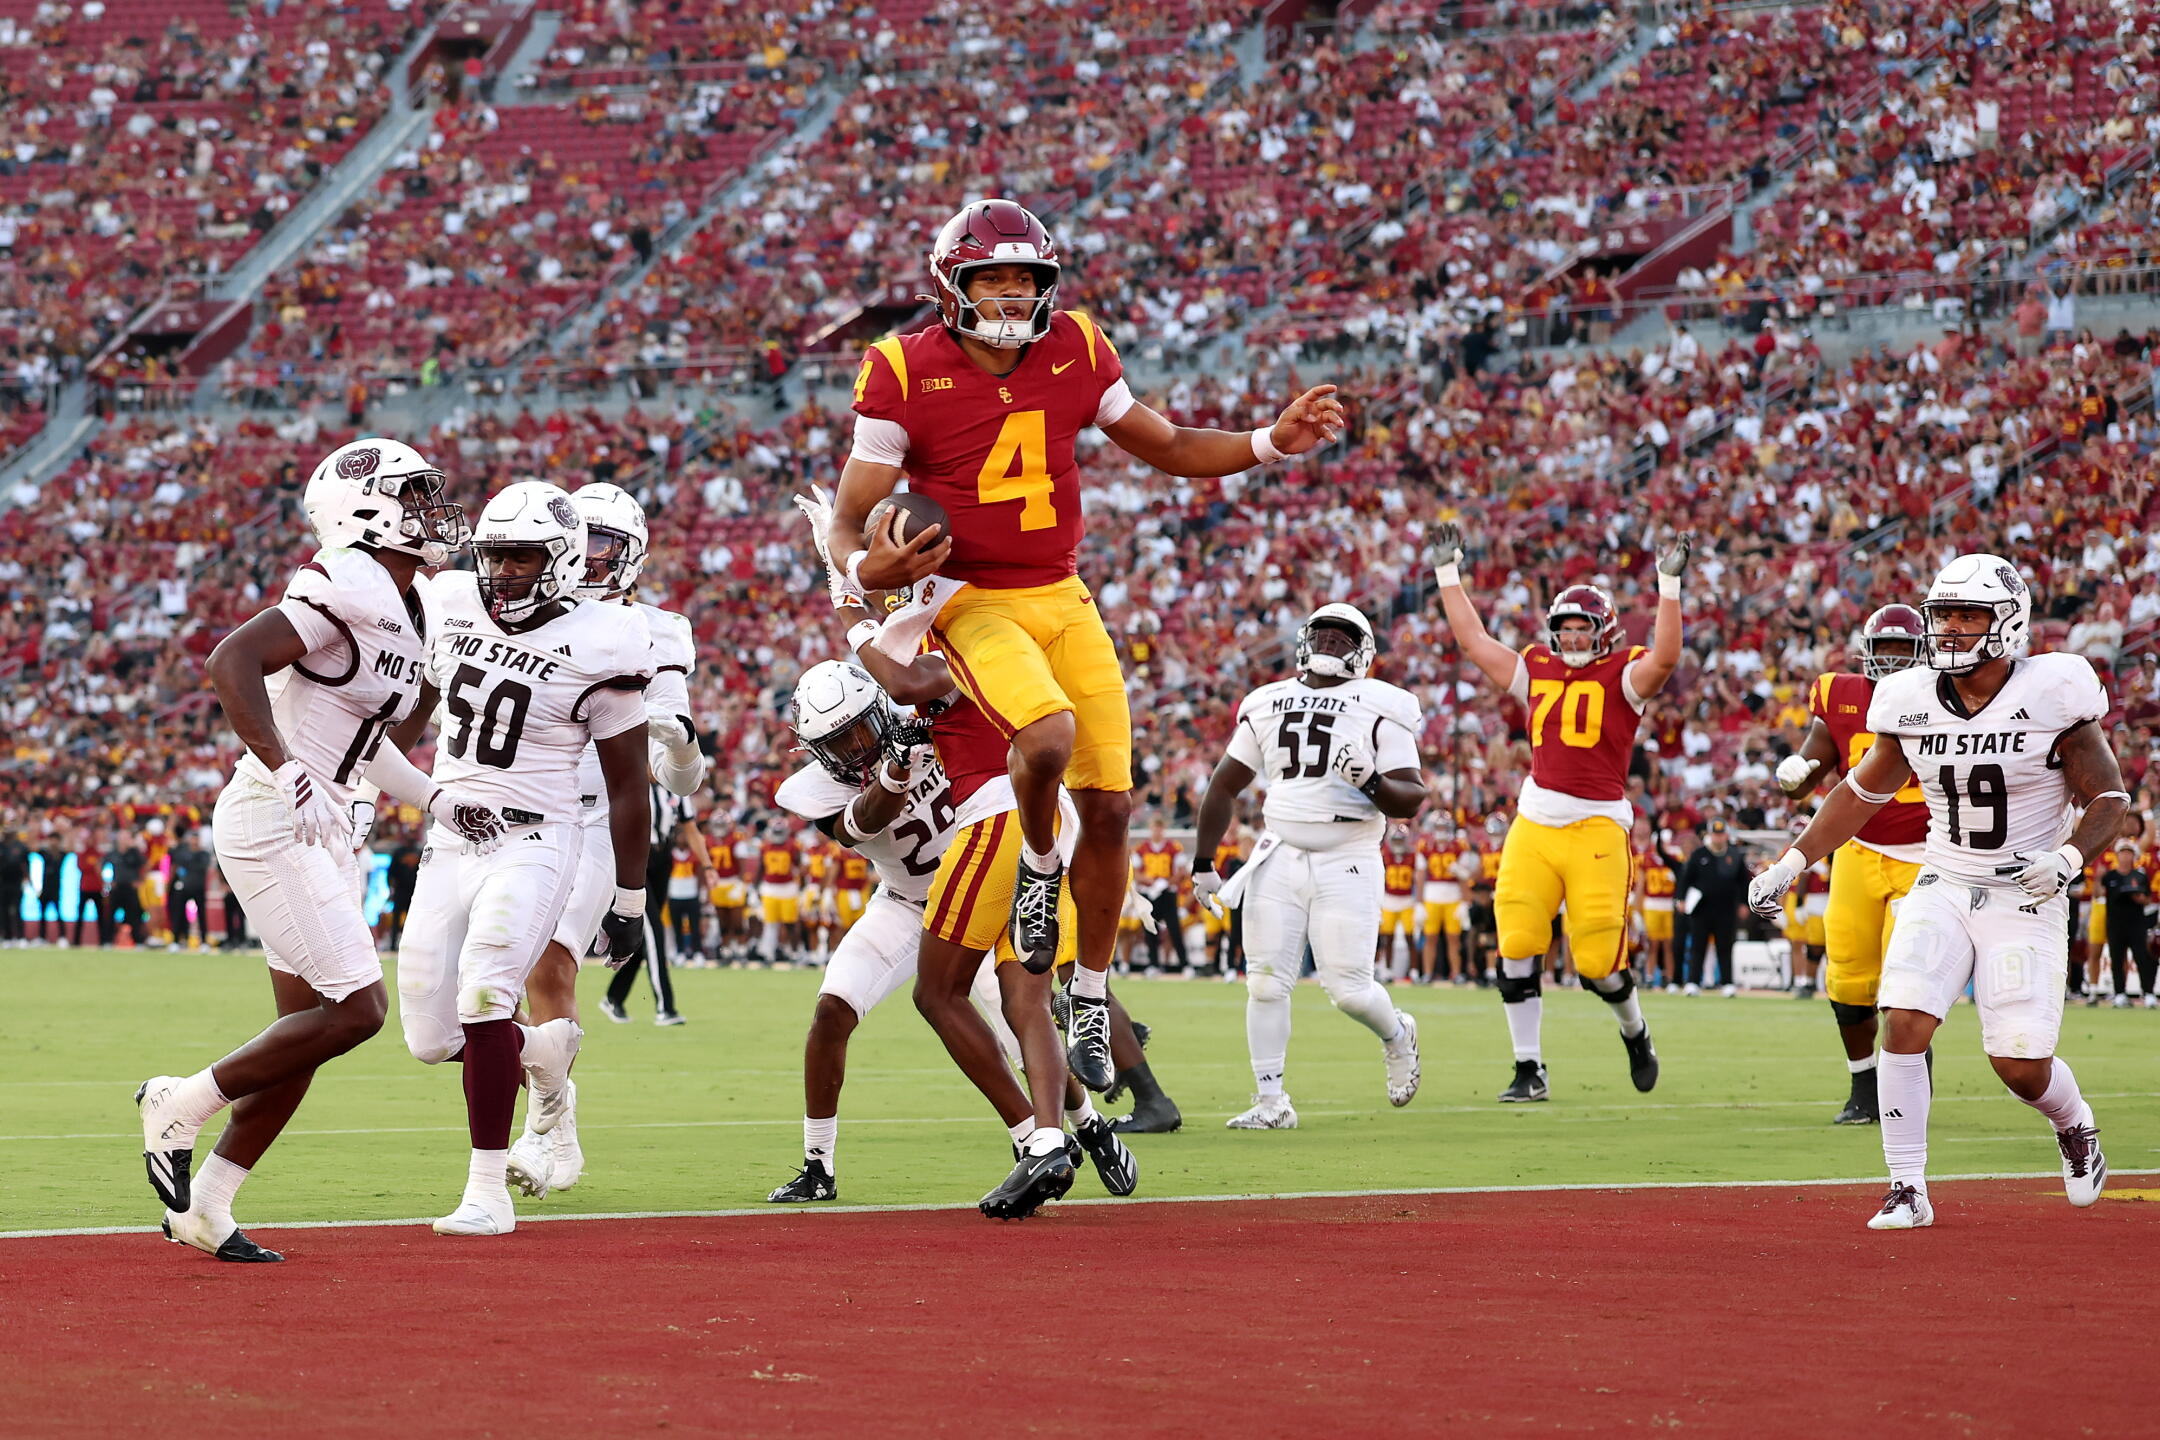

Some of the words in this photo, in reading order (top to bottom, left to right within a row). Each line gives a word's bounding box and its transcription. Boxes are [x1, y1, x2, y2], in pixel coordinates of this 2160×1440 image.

[853, 360, 874, 403] 4
[977, 409, 1058, 532] 4
[374, 649, 405, 680] MO
[450, 635, 483, 657] MO
[484, 642, 560, 682] STATE
[447, 662, 532, 770] 50
[1272, 697, 1294, 713] MO
[1298, 696, 1348, 713] STATE
[1529, 679, 1605, 749] 70
[1278, 712, 1336, 780] 55
[1919, 733, 1948, 756] MO
[1955, 731, 2027, 755] STATE
[1938, 763, 2008, 850] 19
